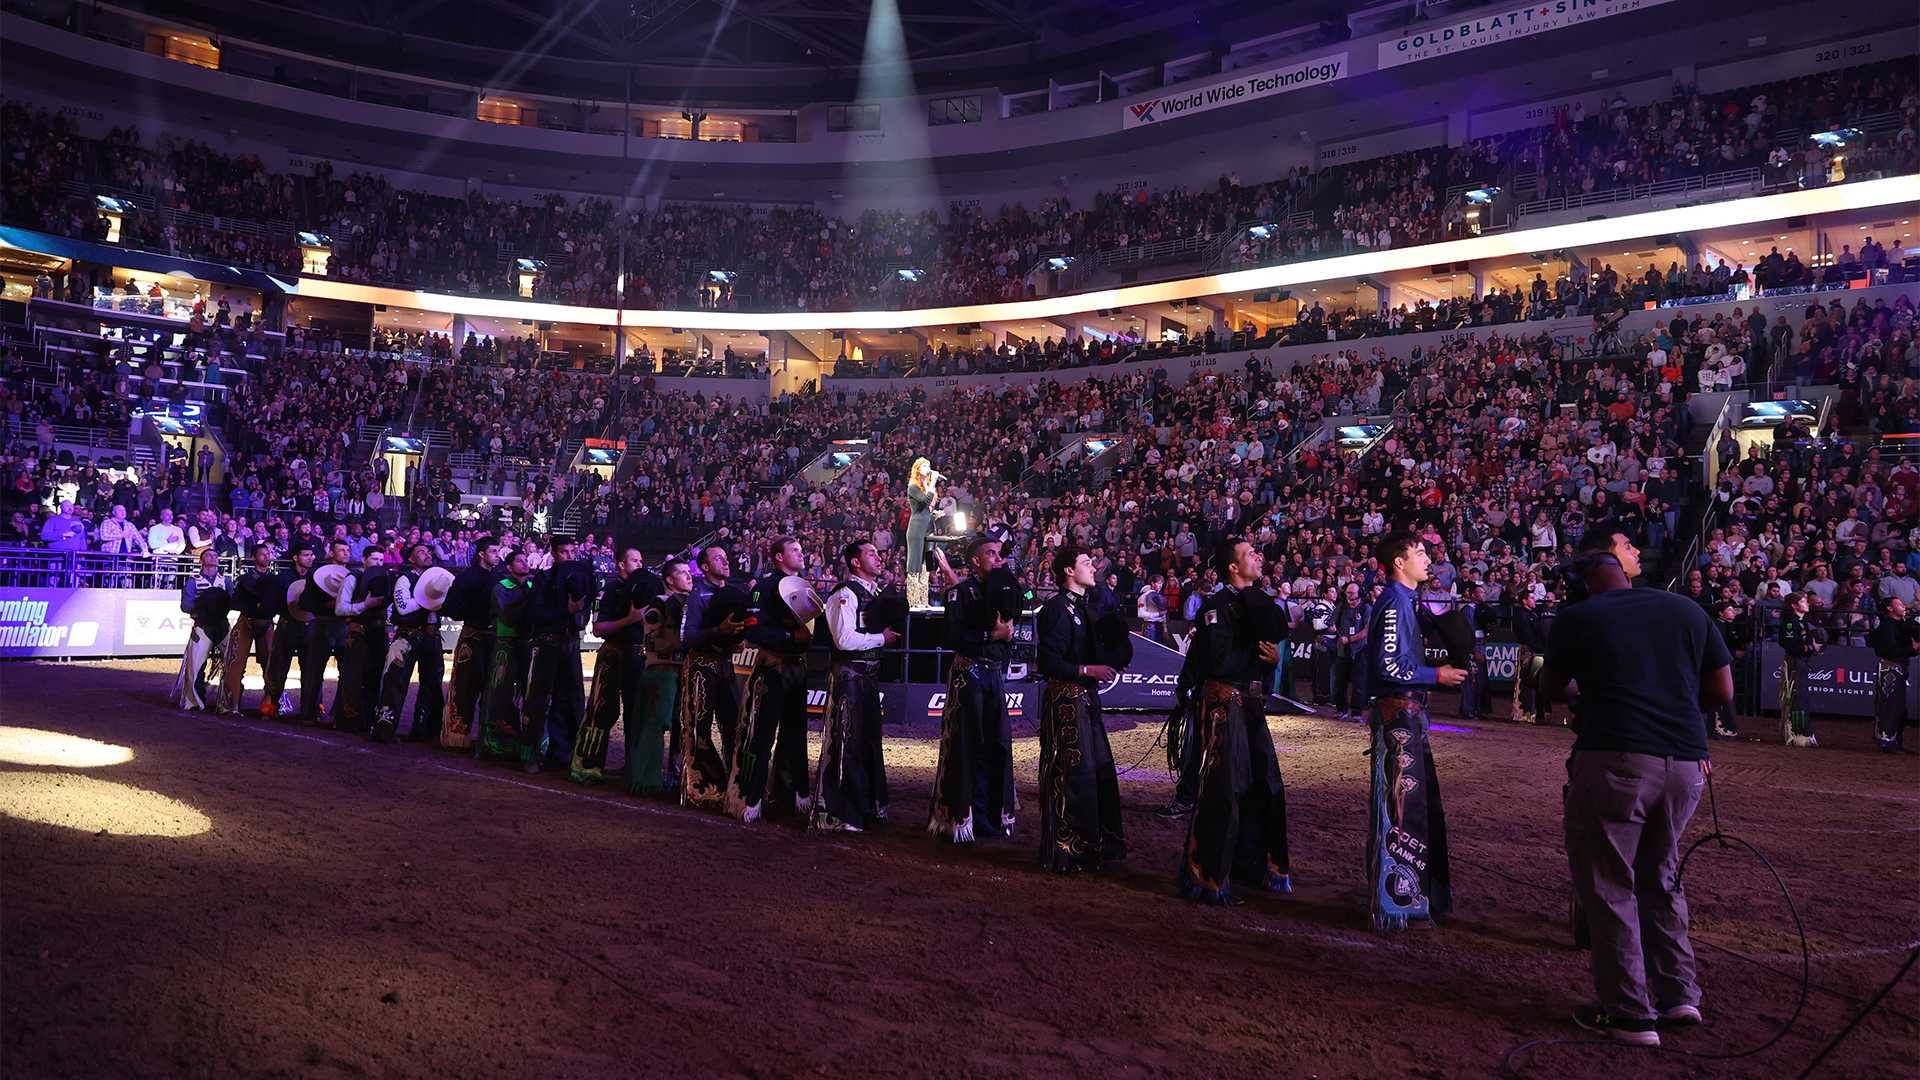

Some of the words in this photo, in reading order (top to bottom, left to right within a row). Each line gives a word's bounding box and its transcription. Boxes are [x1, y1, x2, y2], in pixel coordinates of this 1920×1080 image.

[1556, 0, 1611, 13] SIN
[1407, 50, 1428, 60] THE
[1463, 33, 1500, 48] LOUIS
[1509, 19, 1558, 37] INJURY
[1567, 11, 1596, 24] LAW
[1605, 0, 1640, 14] FIRM
[1815, 50, 1840, 62] 320
[1849, 43, 1873, 56] 321
[1161, 93, 1203, 115] World
[1207, 86, 1245, 104] Wide
[1247, 61, 1342, 94] Technology
[1525, 108, 1543, 119] 319
[1383, 609, 1398, 653] NITRO
[1849, 671, 1877, 684] UL
[1151, 688, 1172, 697] Home
